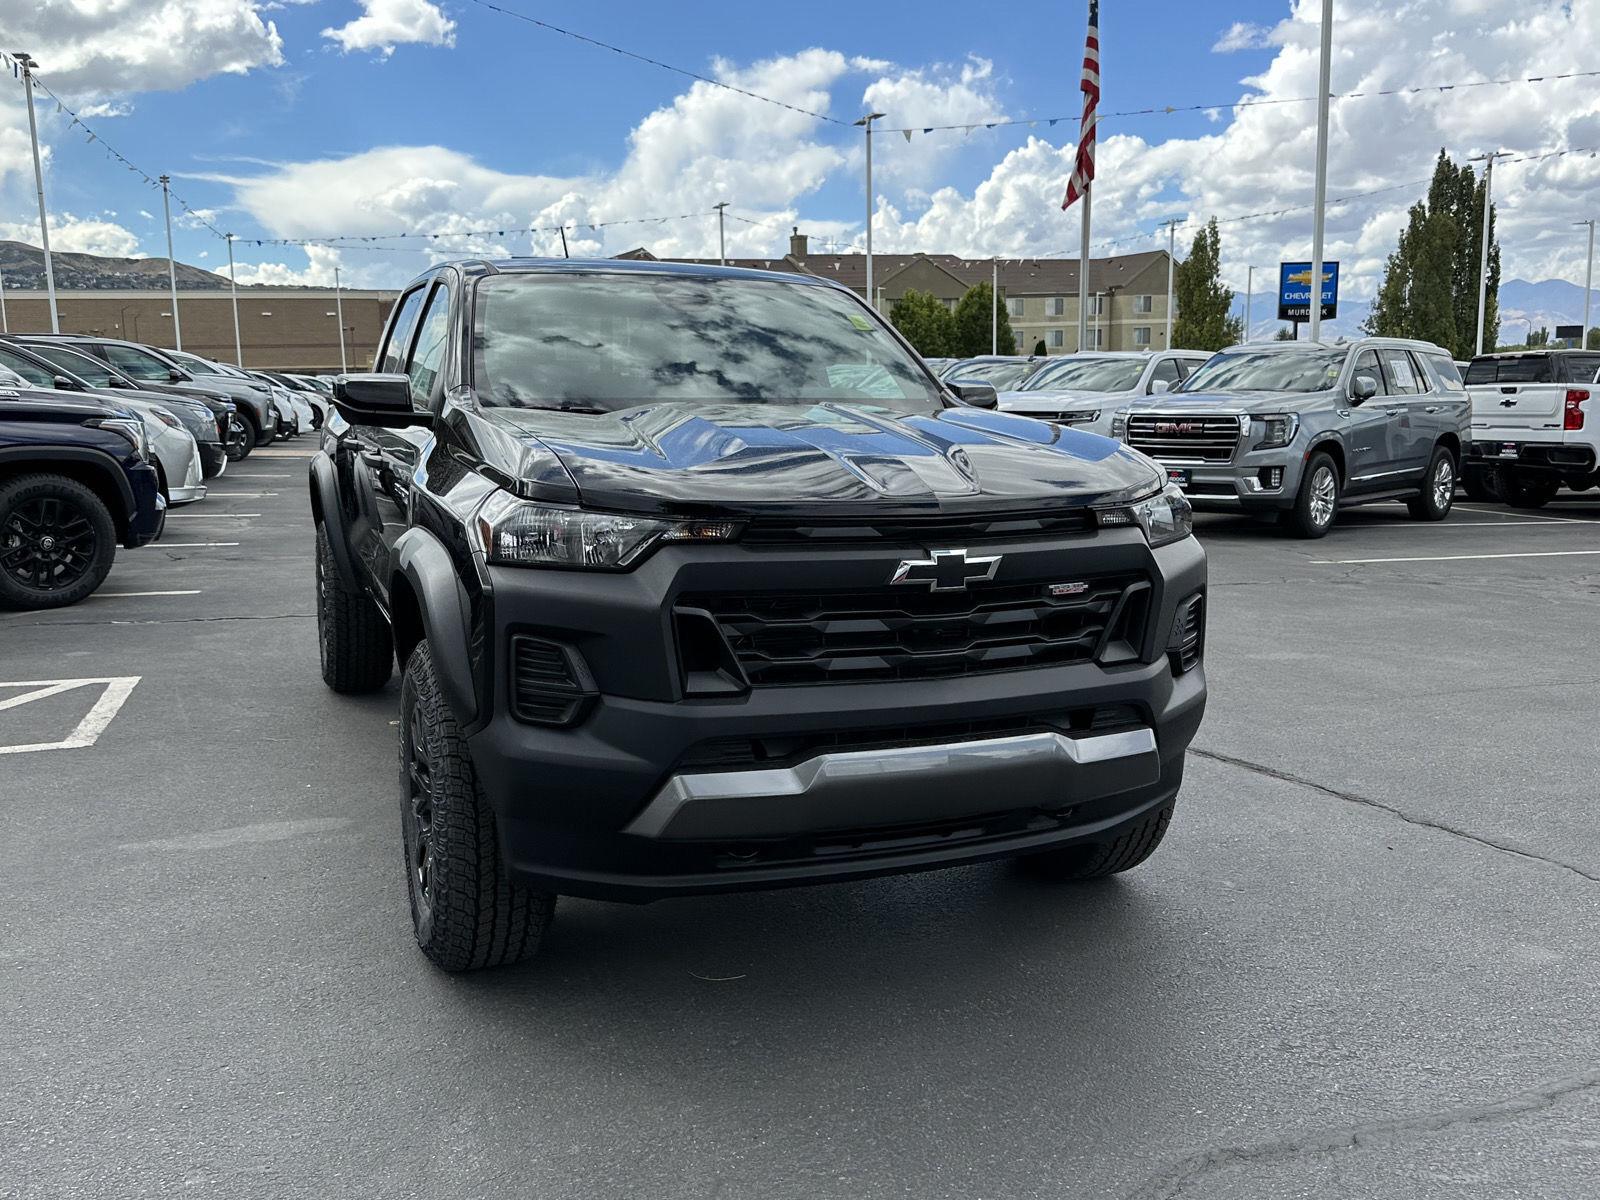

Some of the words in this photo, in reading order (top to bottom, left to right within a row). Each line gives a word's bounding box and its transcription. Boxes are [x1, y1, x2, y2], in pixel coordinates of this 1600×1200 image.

[1284, 292, 1332, 300] CHEVRET
[1287, 308, 1328, 316] MURDK
[1155, 422, 1202, 433] GMC
